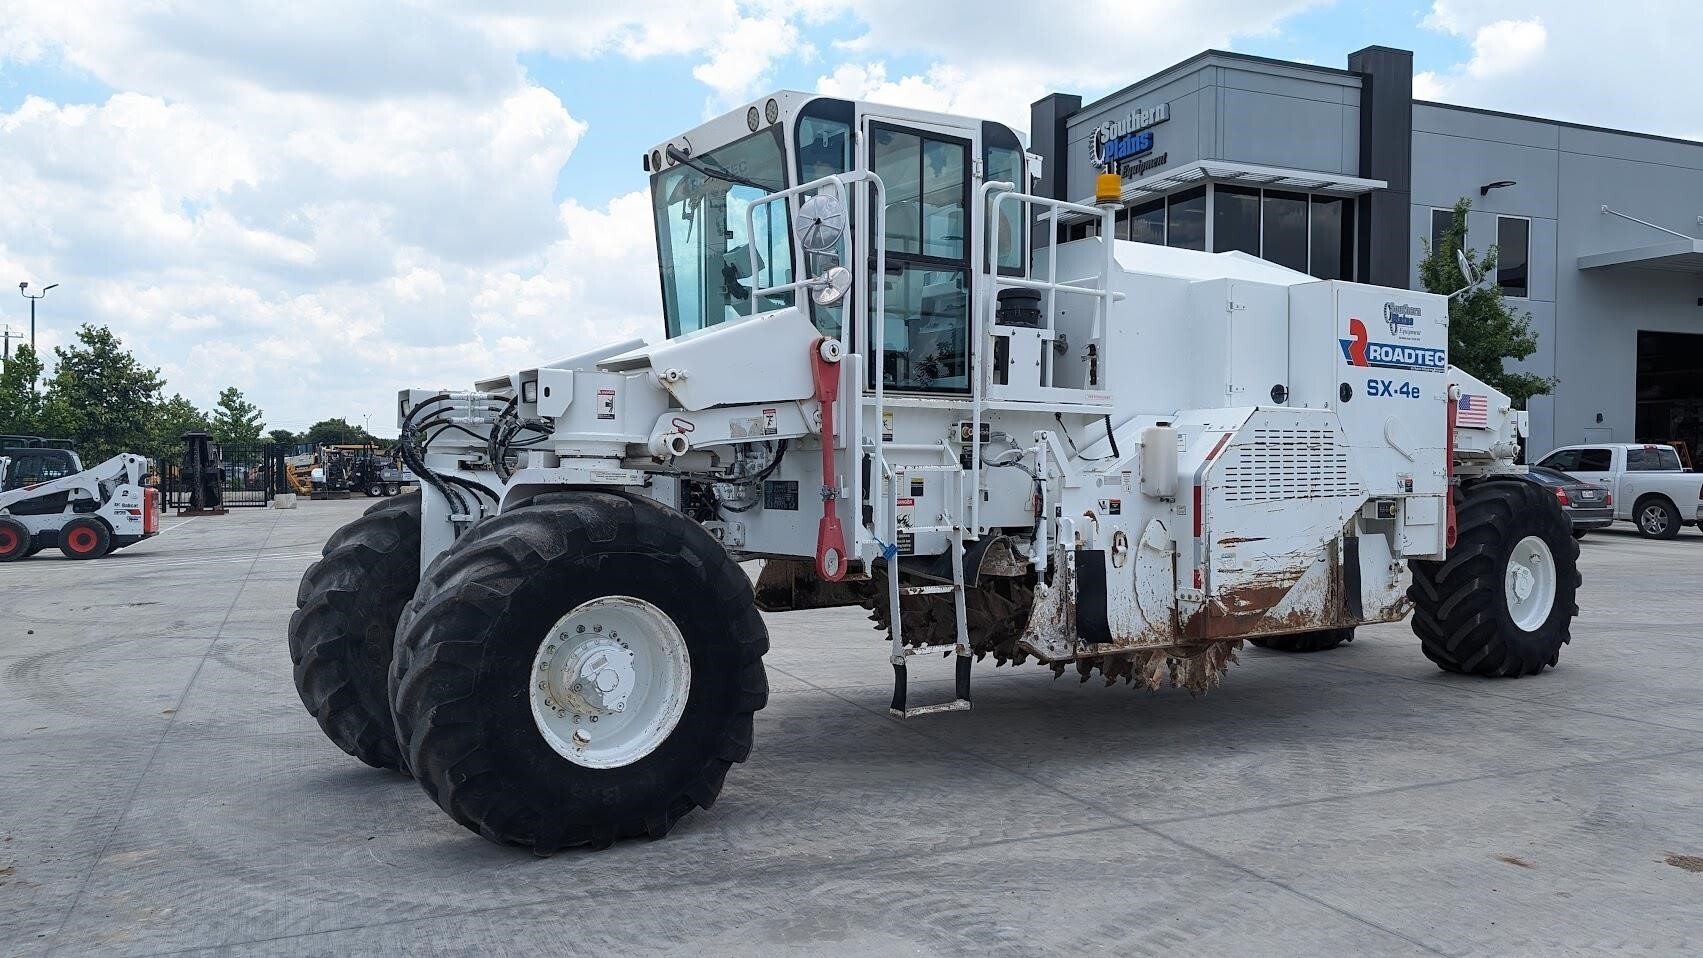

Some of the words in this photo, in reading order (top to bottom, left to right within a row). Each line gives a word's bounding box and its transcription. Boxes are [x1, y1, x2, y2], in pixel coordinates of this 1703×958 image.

[1100, 103, 1169, 143] Southern
[1104, 131, 1153, 163] Plains
[1121, 152, 1168, 179] Equipment
[1390, 302, 1421, 316] Southern
[1369, 345, 1445, 368] ROADTEC
[1367, 379, 1420, 399] SX-4e
